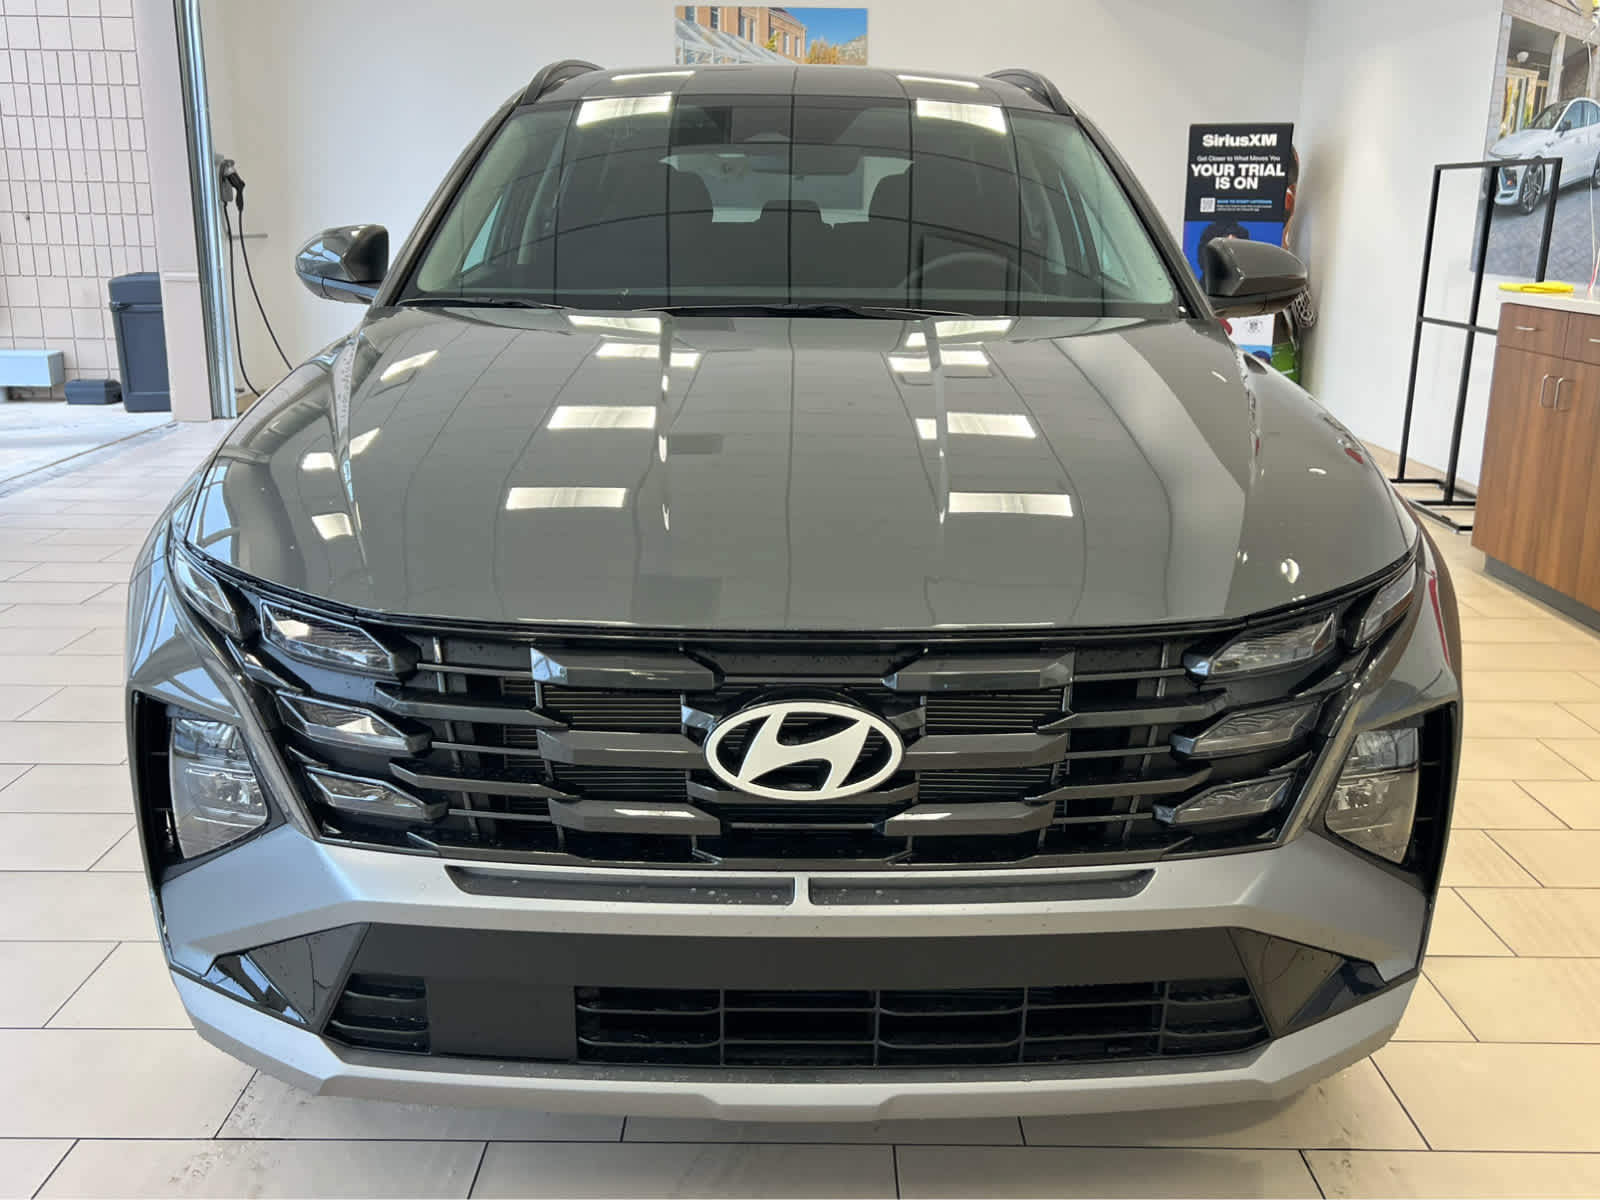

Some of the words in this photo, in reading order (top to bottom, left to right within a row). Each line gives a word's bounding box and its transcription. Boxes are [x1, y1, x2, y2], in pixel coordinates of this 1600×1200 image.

[1202, 133, 1278, 147] SiriusXM
[1191, 163, 1235, 177] YOUR
[1238, 163, 1286, 177] TRIAL
[1215, 177, 1230, 190] IS
[1233, 177, 1258, 190] ON
